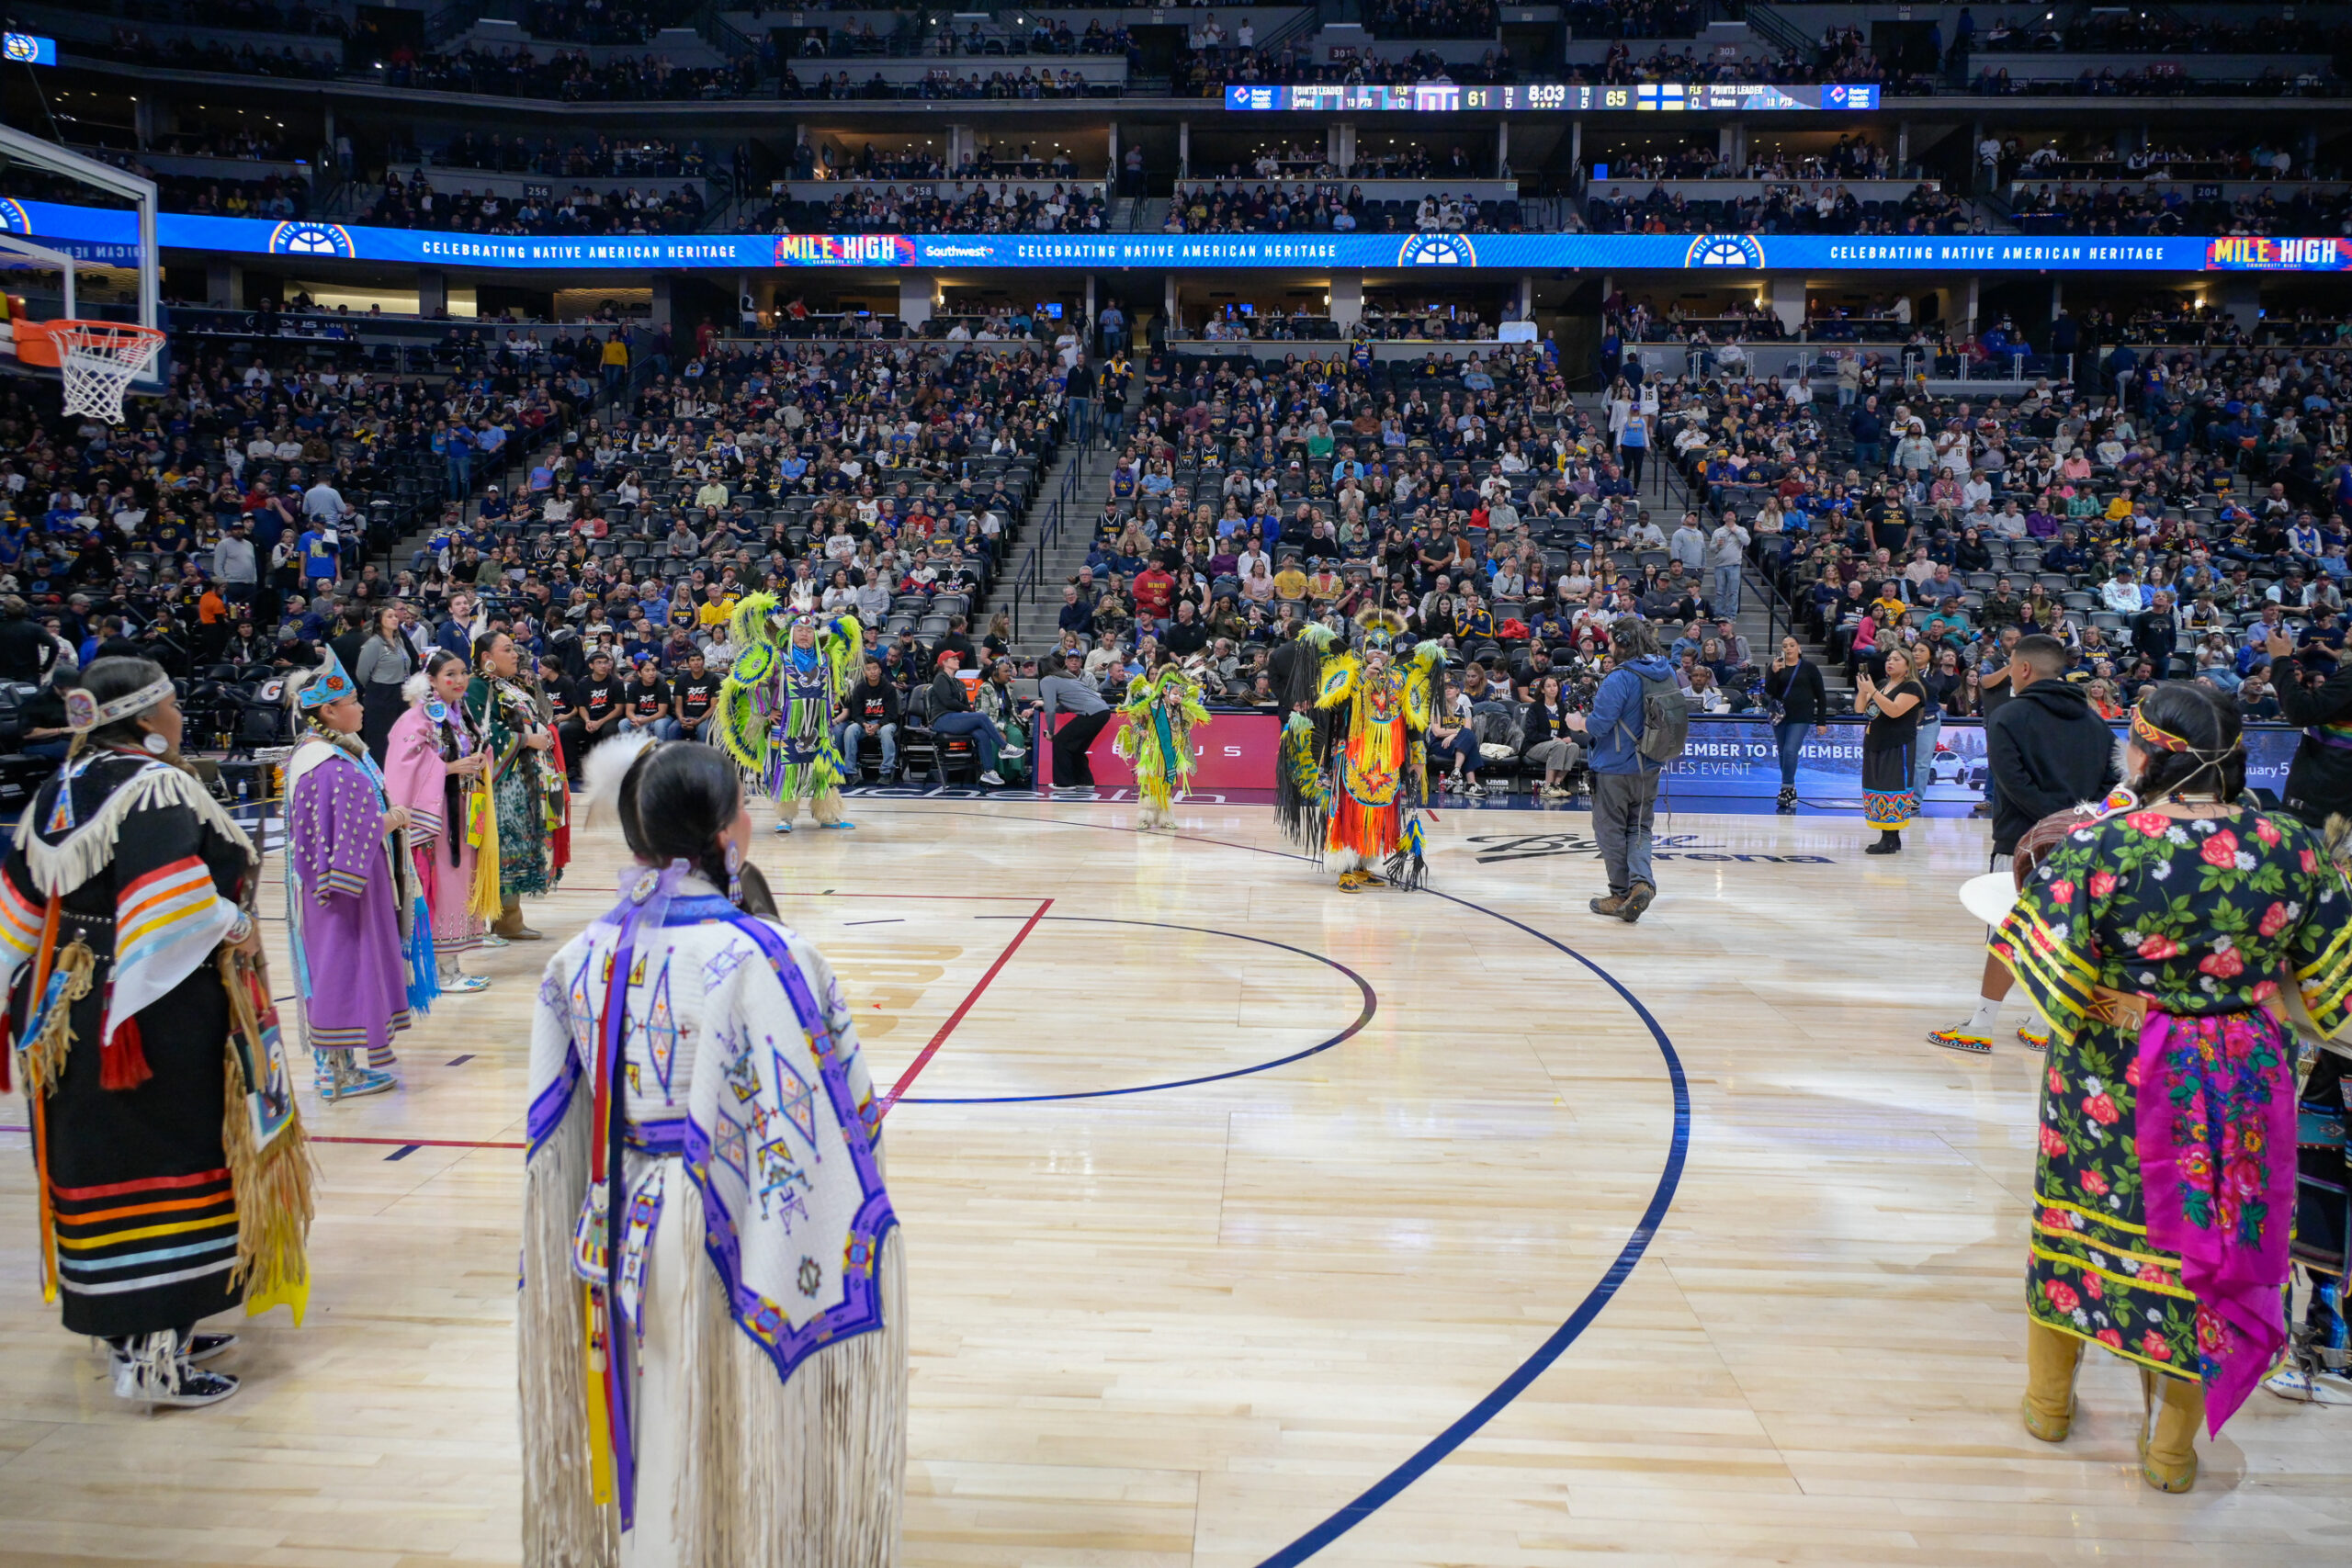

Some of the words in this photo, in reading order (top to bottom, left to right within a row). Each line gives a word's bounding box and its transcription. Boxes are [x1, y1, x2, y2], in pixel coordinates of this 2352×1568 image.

[1334, 50, 1351, 58] 301
[1719, 48, 1736, 56] 303
[2155, 65, 2175, 74] 35
[1467, 91, 1487, 107] 61
[1529, 85, 1566, 101] 8:03
[1605, 91, 1627, 107] 65
[1505, 97, 1513, 109] 5
[1580, 97, 1589, 109] 5
[1691, 97, 1700, 108] 0
[528, 186, 548, 197] 256
[2198, 187, 2218, 197] 204
[277, 224, 297, 245] MILE
[328, 228, 347, 248] CITY
[423, 242, 525, 258] CELEBRATING
[533, 246, 582, 258] NATIVE
[589, 246, 660, 258] AMERICAN
[668, 245, 736, 258] HERITAGE
[782, 236, 834, 259] MILE
[842, 236, 895, 259] HIGH
[926, 245, 986, 257] Southwest
[1018, 245, 1115, 257] CELEBRATING
[1125, 245, 1174, 257] NATIVE
[1182, 245, 1256, 257] AMERICAN
[1264, 245, 1336, 257] HERITAGE
[1405, 237, 1423, 258] MILE
[1453, 238, 1469, 257] CITY
[1692, 238, 1712, 259] MILE
[1741, 238, 1758, 259] CITY
[1830, 246, 1933, 259] CELEBRATING
[1941, 246, 1995, 259] NATIVE
[2003, 247, 2081, 260] AMERICAN
[2089, 247, 2164, 260] HERITAGE
[2214, 239, 2271, 263] MILE
[2280, 239, 2337, 263] HIGH
[1645, 391, 1653, 400] 15
[1955, 448, 1963, 457] 15
[678, 616, 688, 625] 32
[261, 681, 284, 701] G
[687, 686, 708, 695] REZ
[686, 694, 707, 702] BALL
[865, 705, 885, 715] BALL
[1679, 743, 1740, 757] EMBER
[1746, 744, 1766, 758] TO
[1772, 745, 1864, 759] RMEMBER
[1660, 761, 1696, 775] ALES
[1702, 761, 1751, 775] EVENT
[2246, 764, 2278, 777] uary
[2279, 762, 2290, 775] 5
